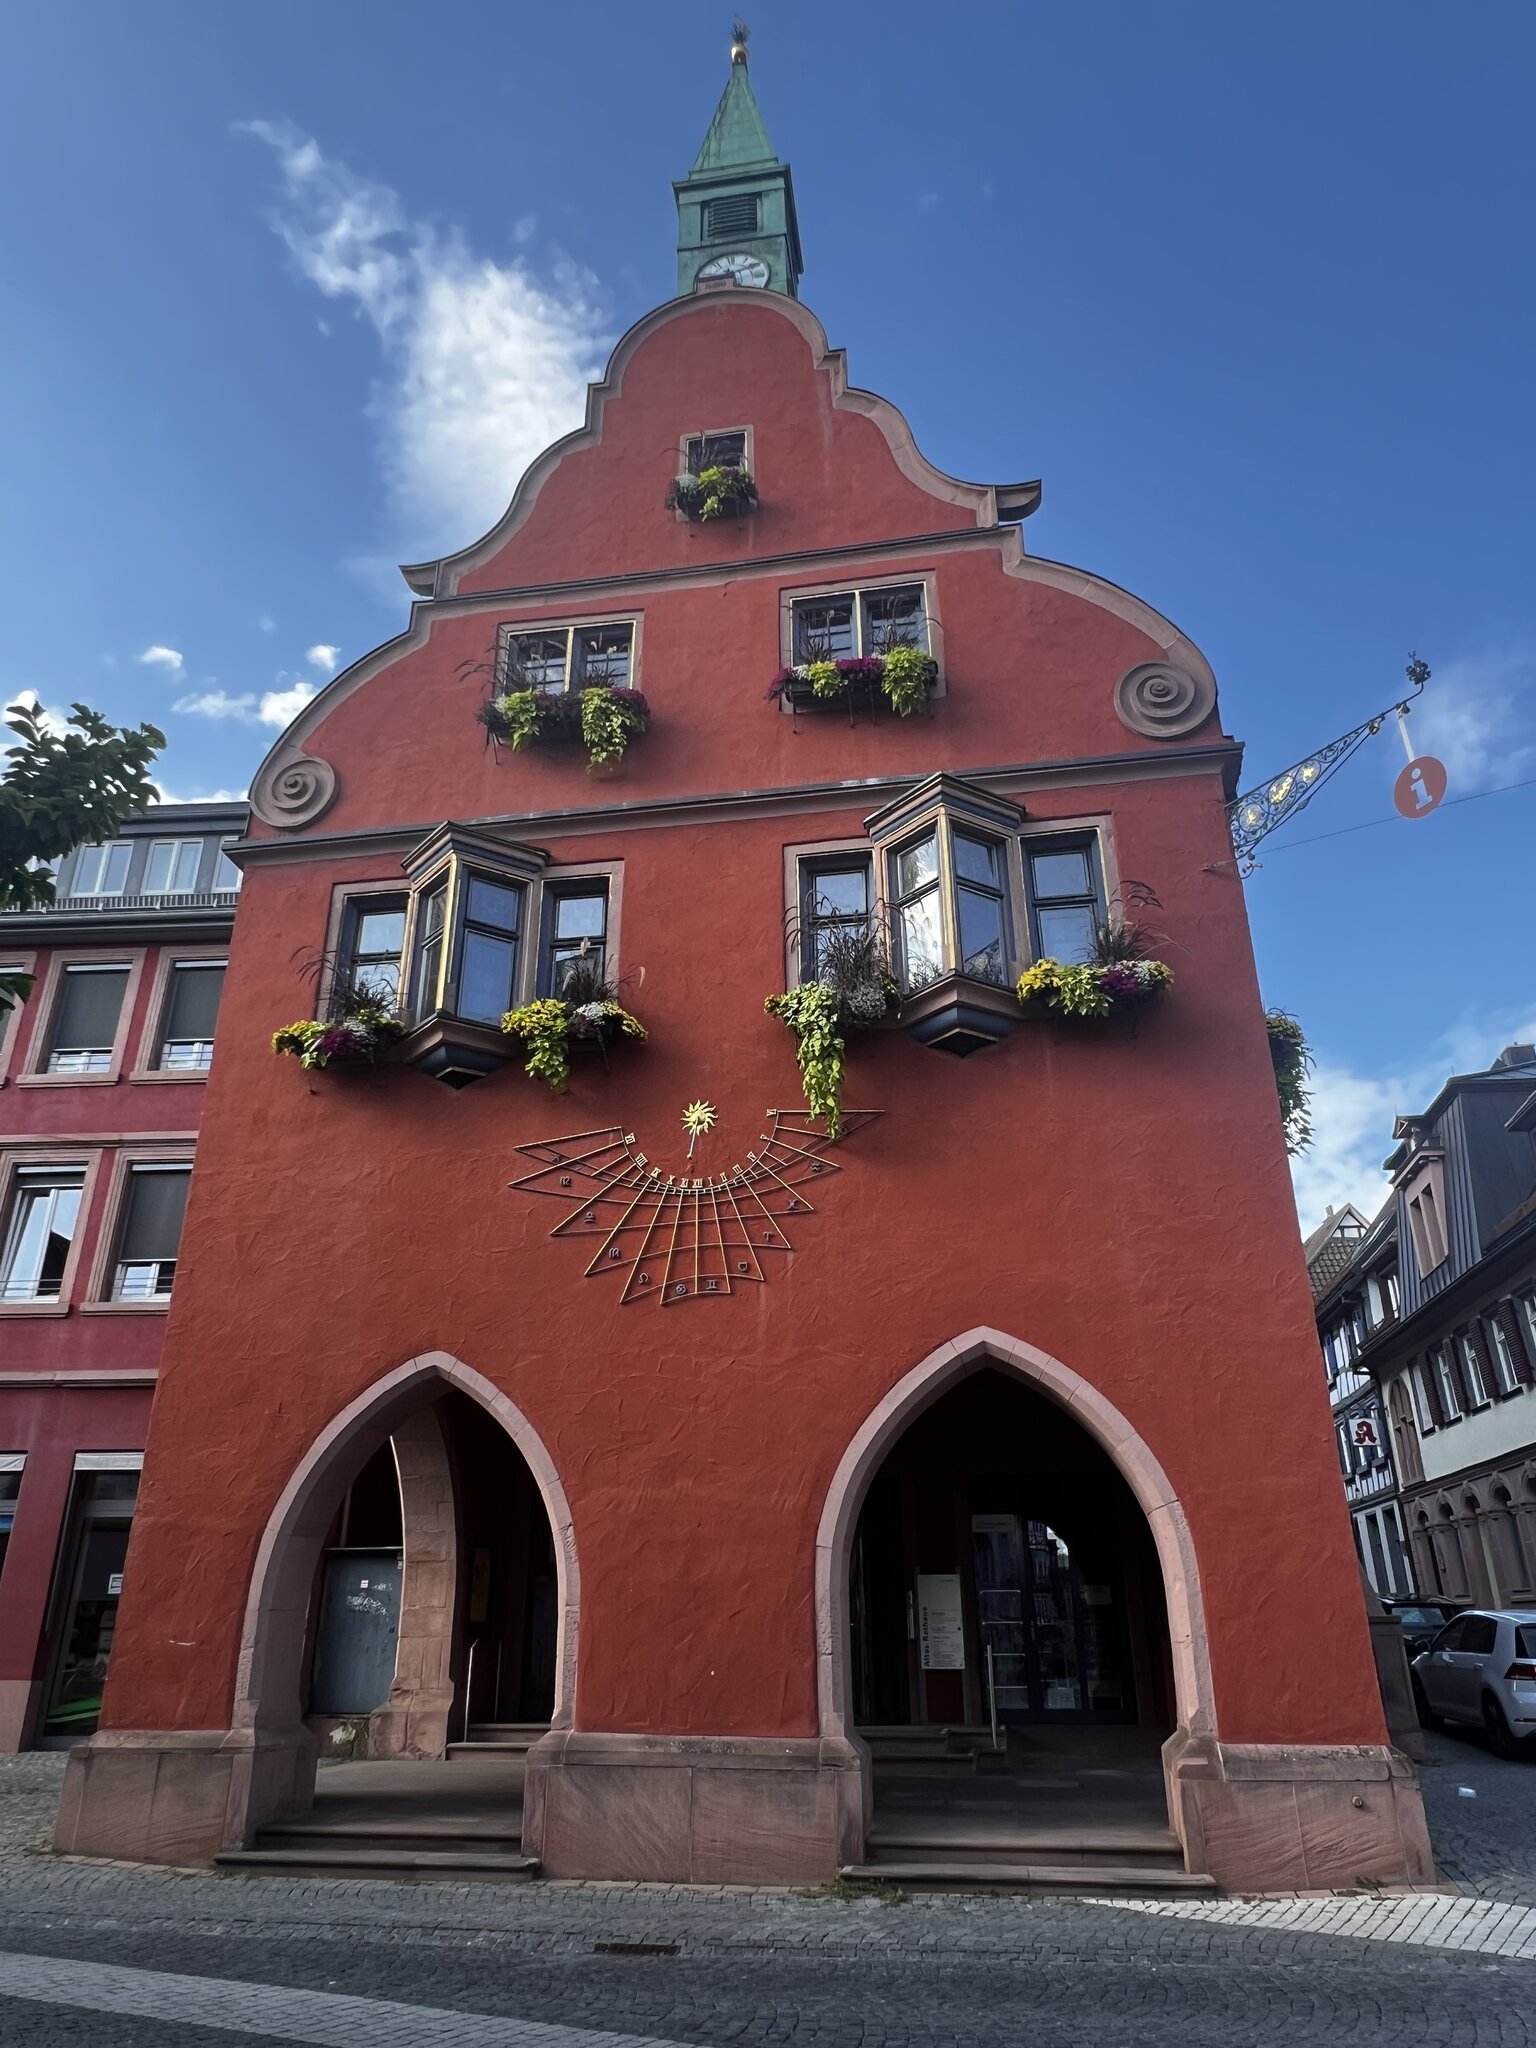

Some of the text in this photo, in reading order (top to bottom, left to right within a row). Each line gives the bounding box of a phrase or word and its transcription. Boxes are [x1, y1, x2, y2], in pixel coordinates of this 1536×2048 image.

[1411, 768, 1432, 810] i
[680, 1178, 689, 1188] XI
[692, 1178, 703, 1188] XII
[720, 1172, 727, 1183] II
[732, 1164, 743, 1175] III
[923, 1644, 931, 1668] Altes
